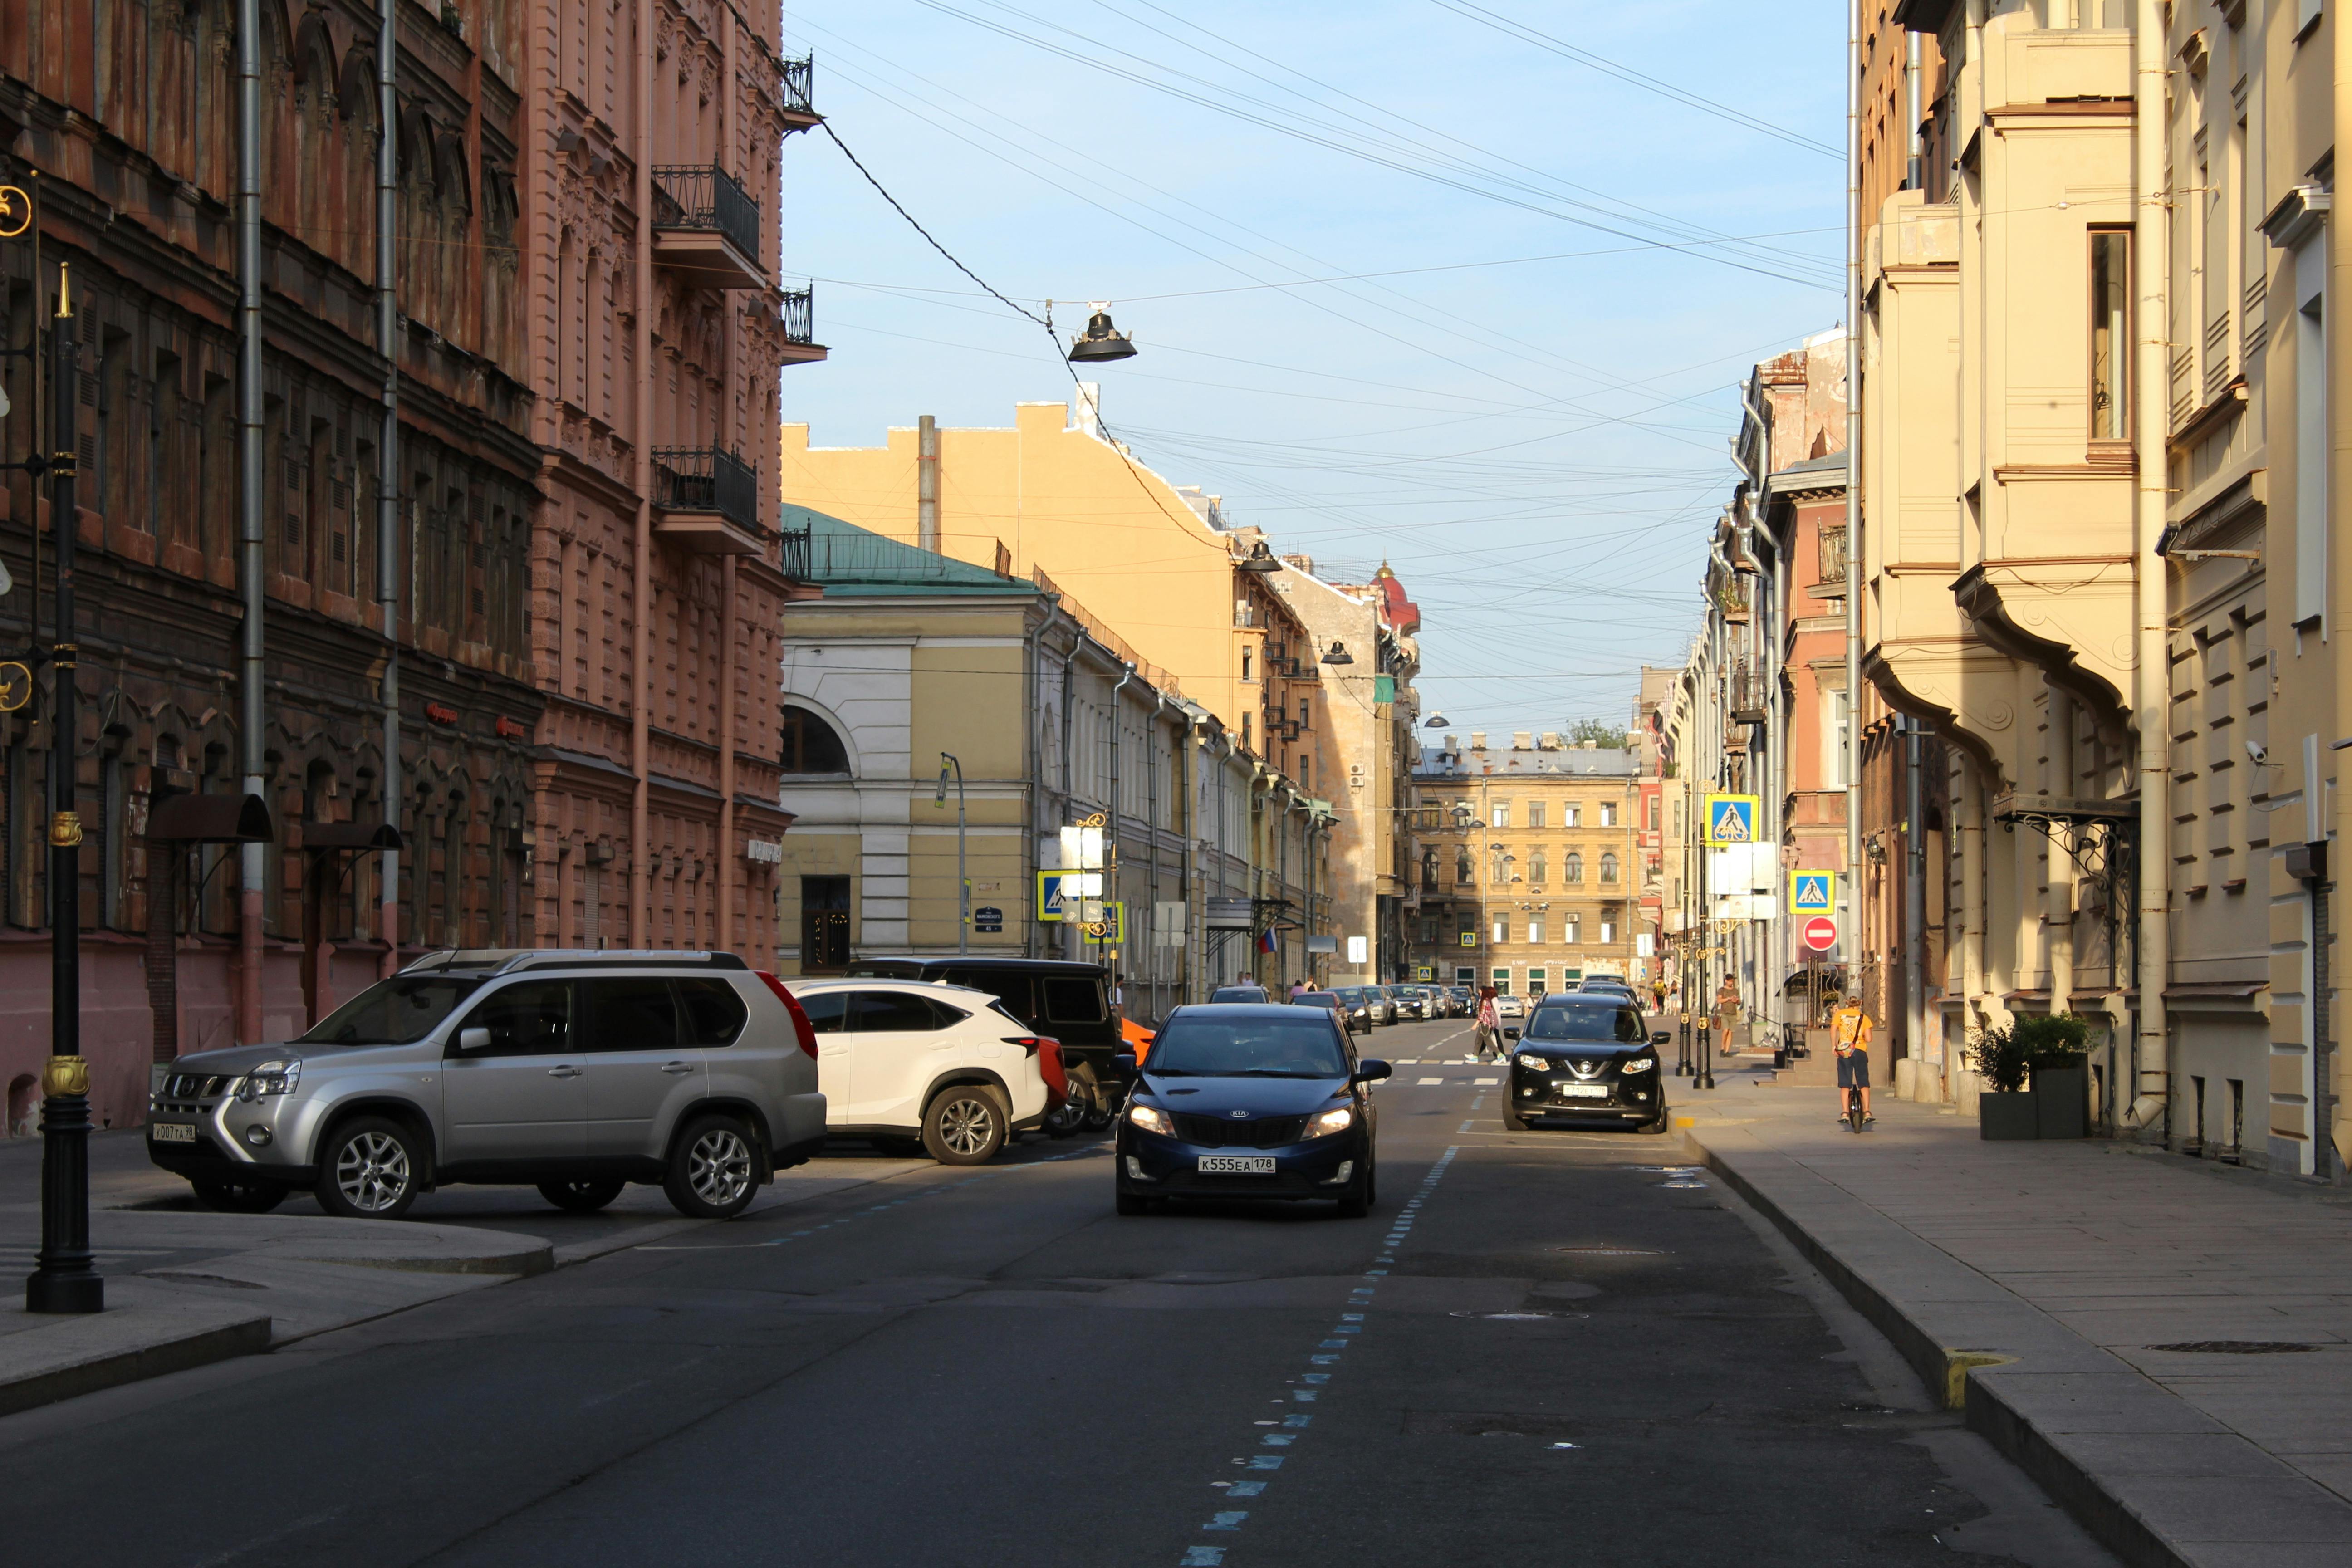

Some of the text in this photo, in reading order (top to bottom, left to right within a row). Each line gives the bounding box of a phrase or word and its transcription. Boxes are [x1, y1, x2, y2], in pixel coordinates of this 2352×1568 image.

[185, 1126, 192, 1136] 98
[1202, 1158, 1272, 1171] К555ЕА 178
